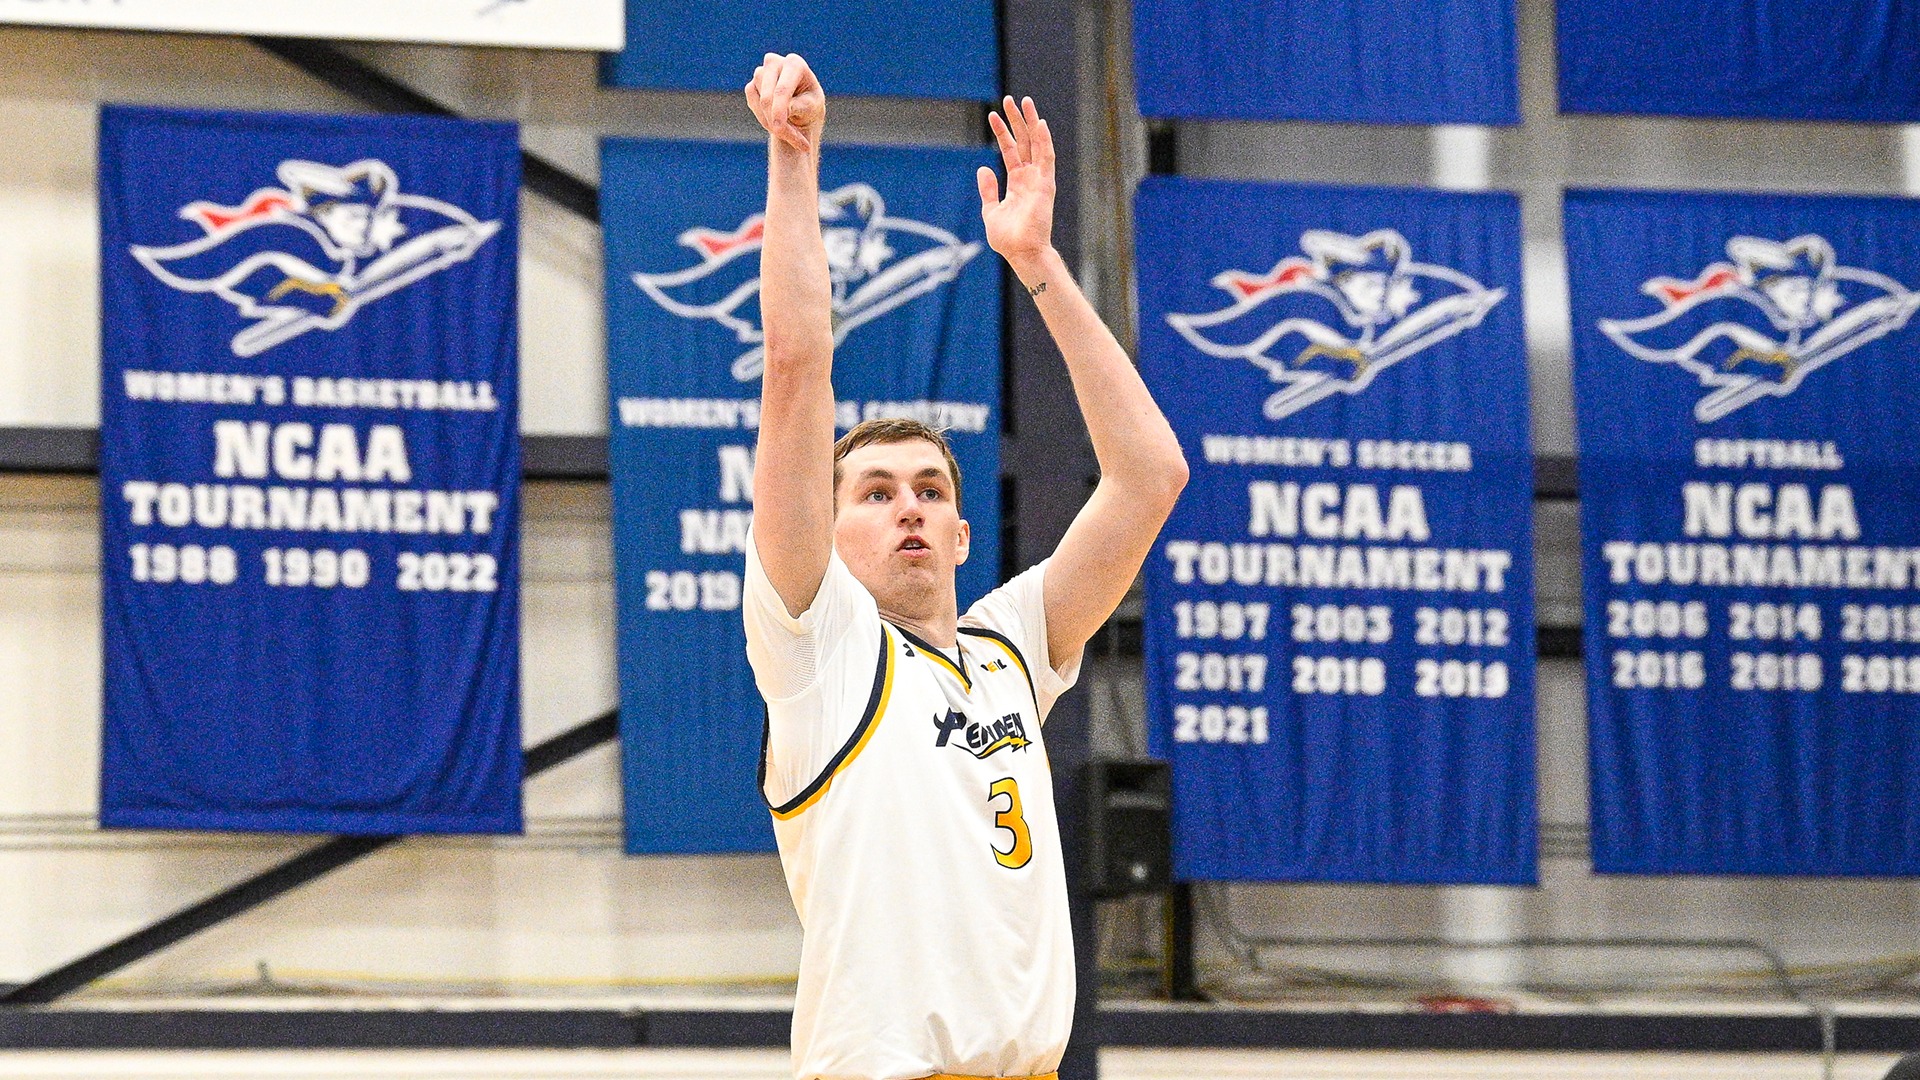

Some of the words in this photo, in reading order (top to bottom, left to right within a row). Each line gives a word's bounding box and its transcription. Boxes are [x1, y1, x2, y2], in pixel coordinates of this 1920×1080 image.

[124, 370, 285, 405] WOMEN'S
[293, 377, 497, 410] BASKETBALL
[214, 421, 411, 481] NCAA
[1203, 435, 1350, 466] WOMEN'S
[1358, 440, 1471, 470] SOCCER
[1696, 439, 1842, 468] SOFTBALL
[123, 481, 498, 534] TOURNAMENT
[1249, 482, 1429, 540] NCAA
[1684, 483, 1859, 538] NCAA
[130, 544, 237, 584] 1988
[263, 548, 369, 588] 1990
[397, 552, 497, 592] 2022
[1166, 541, 1510, 592] TOURNAMENT
[646, 571, 740, 610] 2019
[1175, 602, 1269, 639] 1997
[1293, 605, 1392, 643] 2003
[1416, 608, 1508, 646] 2012
[1609, 601, 1706, 637] 2006
[1730, 603, 1821, 639] 2014
[1176, 653, 1267, 691] 2017
[1293, 656, 1385, 695] 2018
[1416, 660, 1508, 698] 2019
[1614, 651, 1704, 688] 2016
[1175, 705, 1268, 743] 2021
[987, 776, 1032, 869] 3
